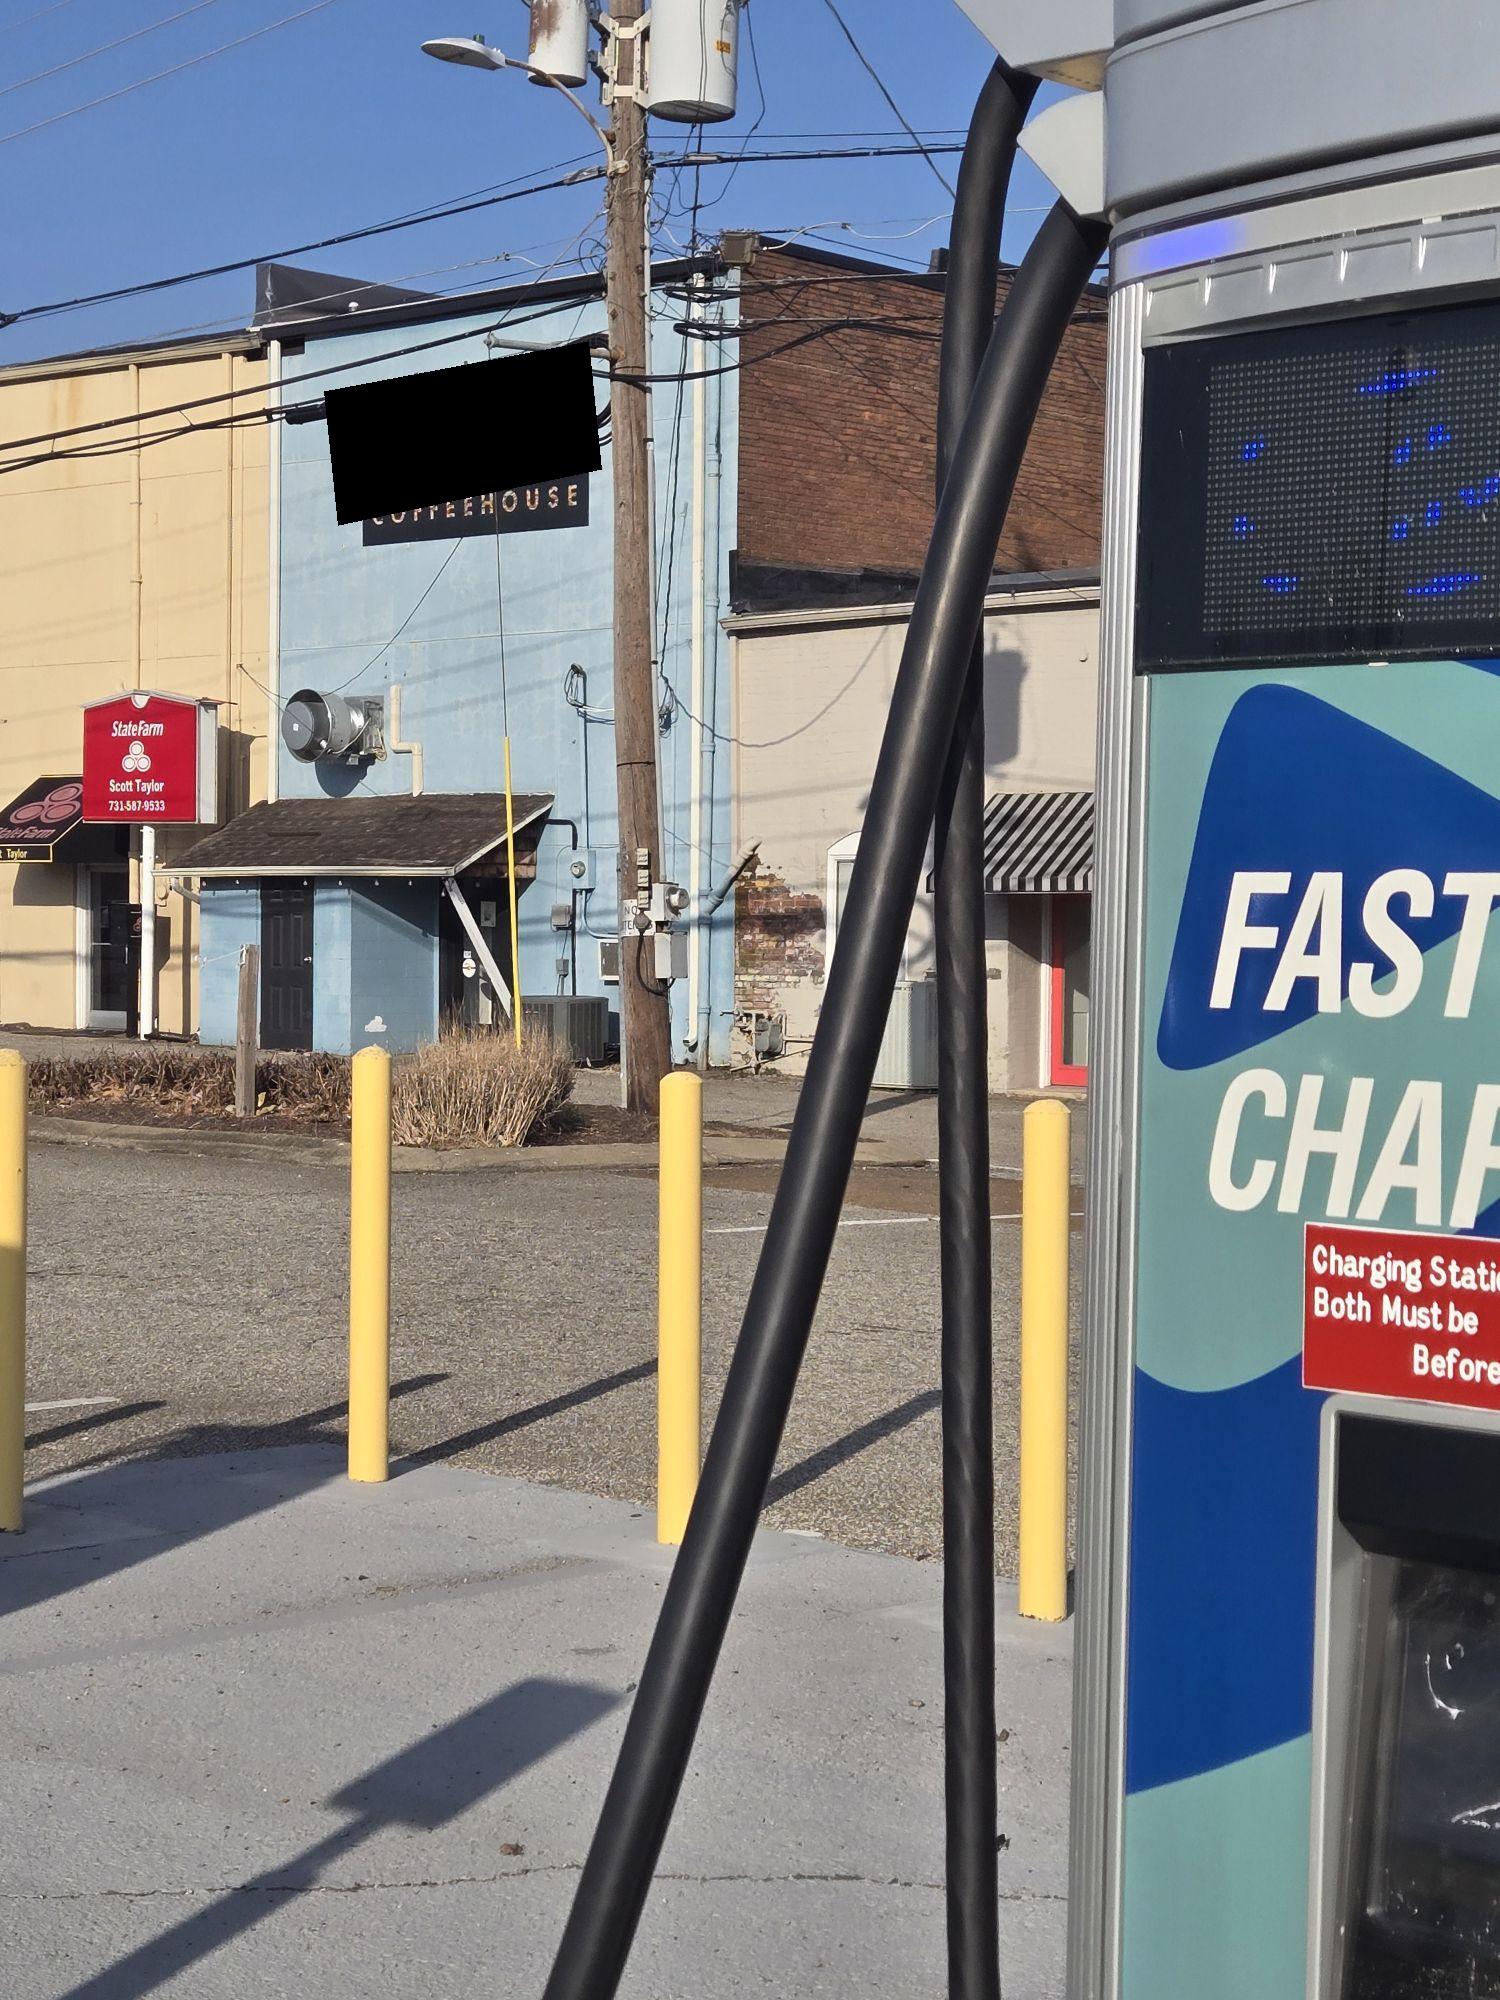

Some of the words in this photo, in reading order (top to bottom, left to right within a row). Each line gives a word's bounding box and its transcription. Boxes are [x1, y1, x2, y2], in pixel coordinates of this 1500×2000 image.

[371, 484, 579, 526] FFEEHOUSE
[108, 800, 166, 812] 731-587-9533
[109, 779, 134, 793] Scott
[135, 779, 165, 796] Taylor
[6, 848, 28, 861] Taylor
[1208, 868, 1500, 1018] FAST
[1312, 1244, 1422, 1293] Charging
[1313, 1286, 1371, 1323] Both
[1382, 1293, 1443, 1331] Must
[1447, 1301, 1479, 1335] be
[1413, 1343, 1500, 1385] Before
